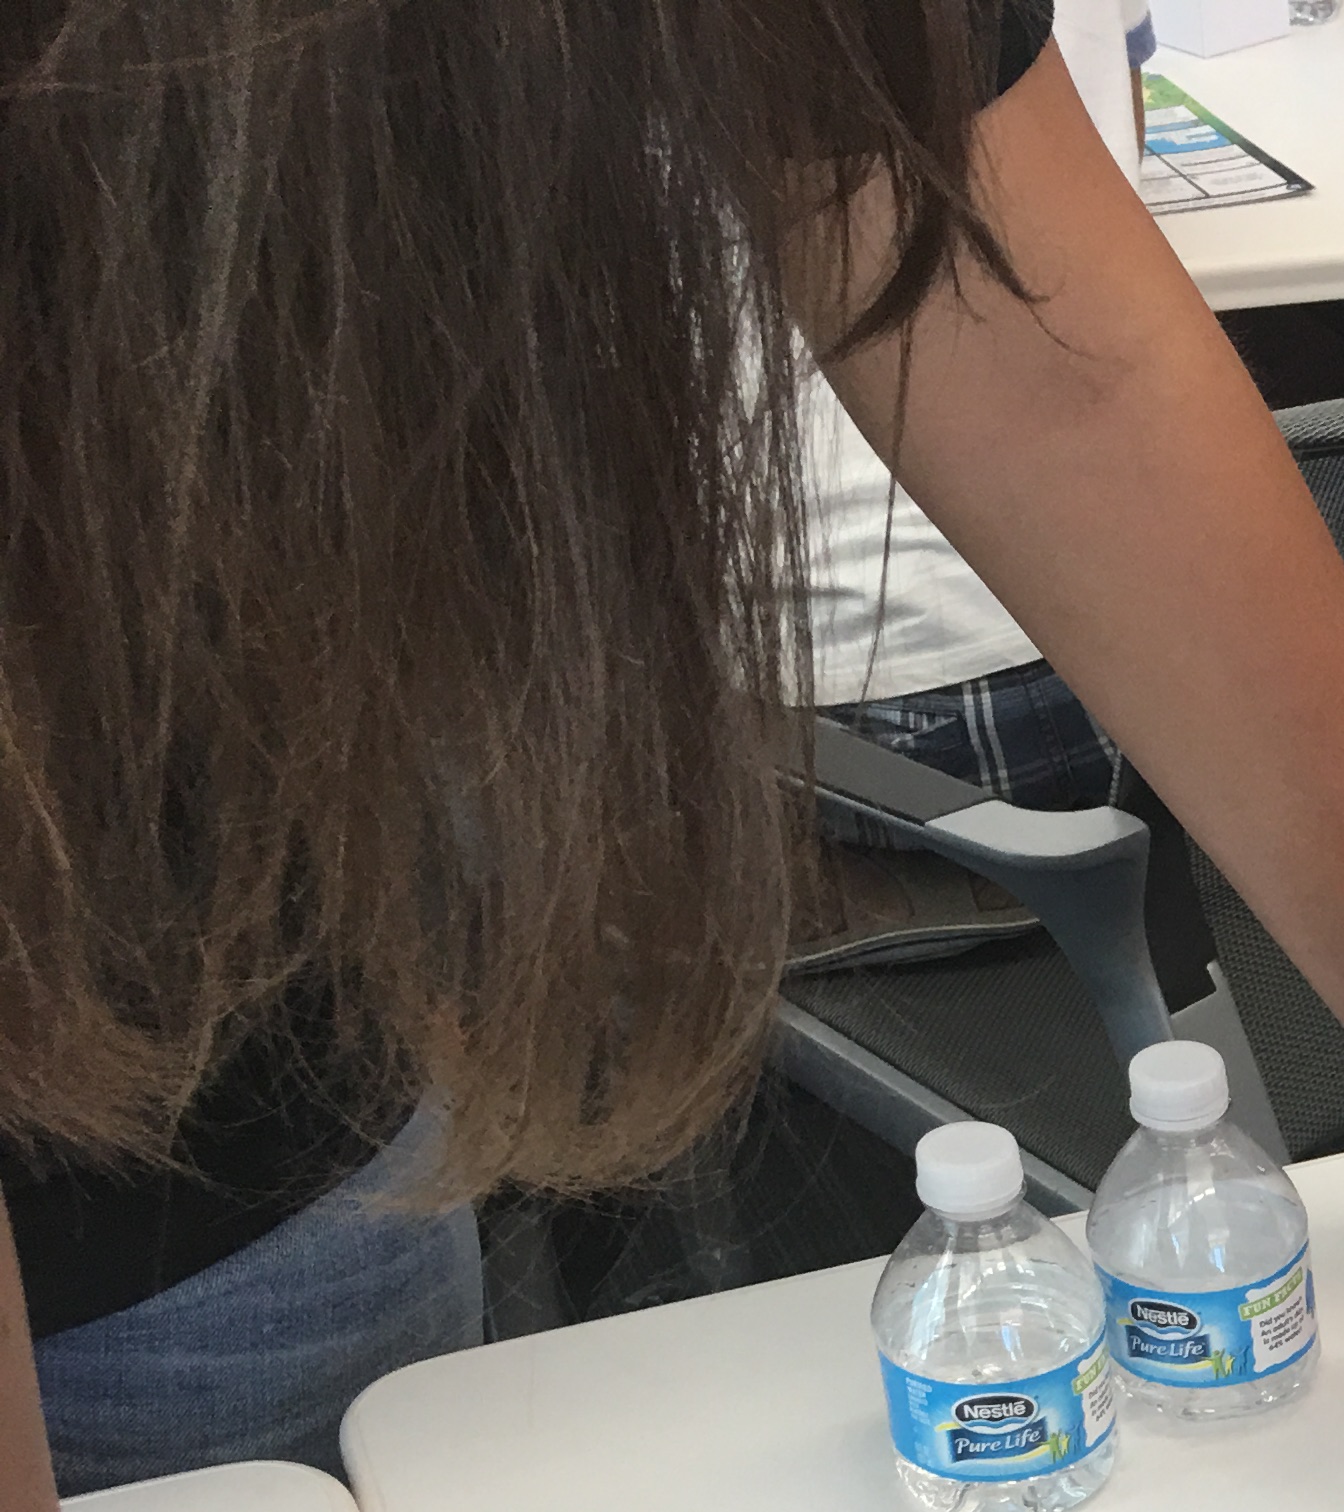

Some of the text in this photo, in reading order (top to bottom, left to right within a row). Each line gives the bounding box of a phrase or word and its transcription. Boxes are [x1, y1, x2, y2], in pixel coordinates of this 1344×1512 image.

[1273, 1270, 1303, 1302] FACT
[1135, 1305, 1190, 1327] Nestlé
[1130, 1336, 1205, 1357] Pure Life
[963, 1400, 1027, 1419] Nestlé
[955, 1429, 1042, 1455] Pure Life
